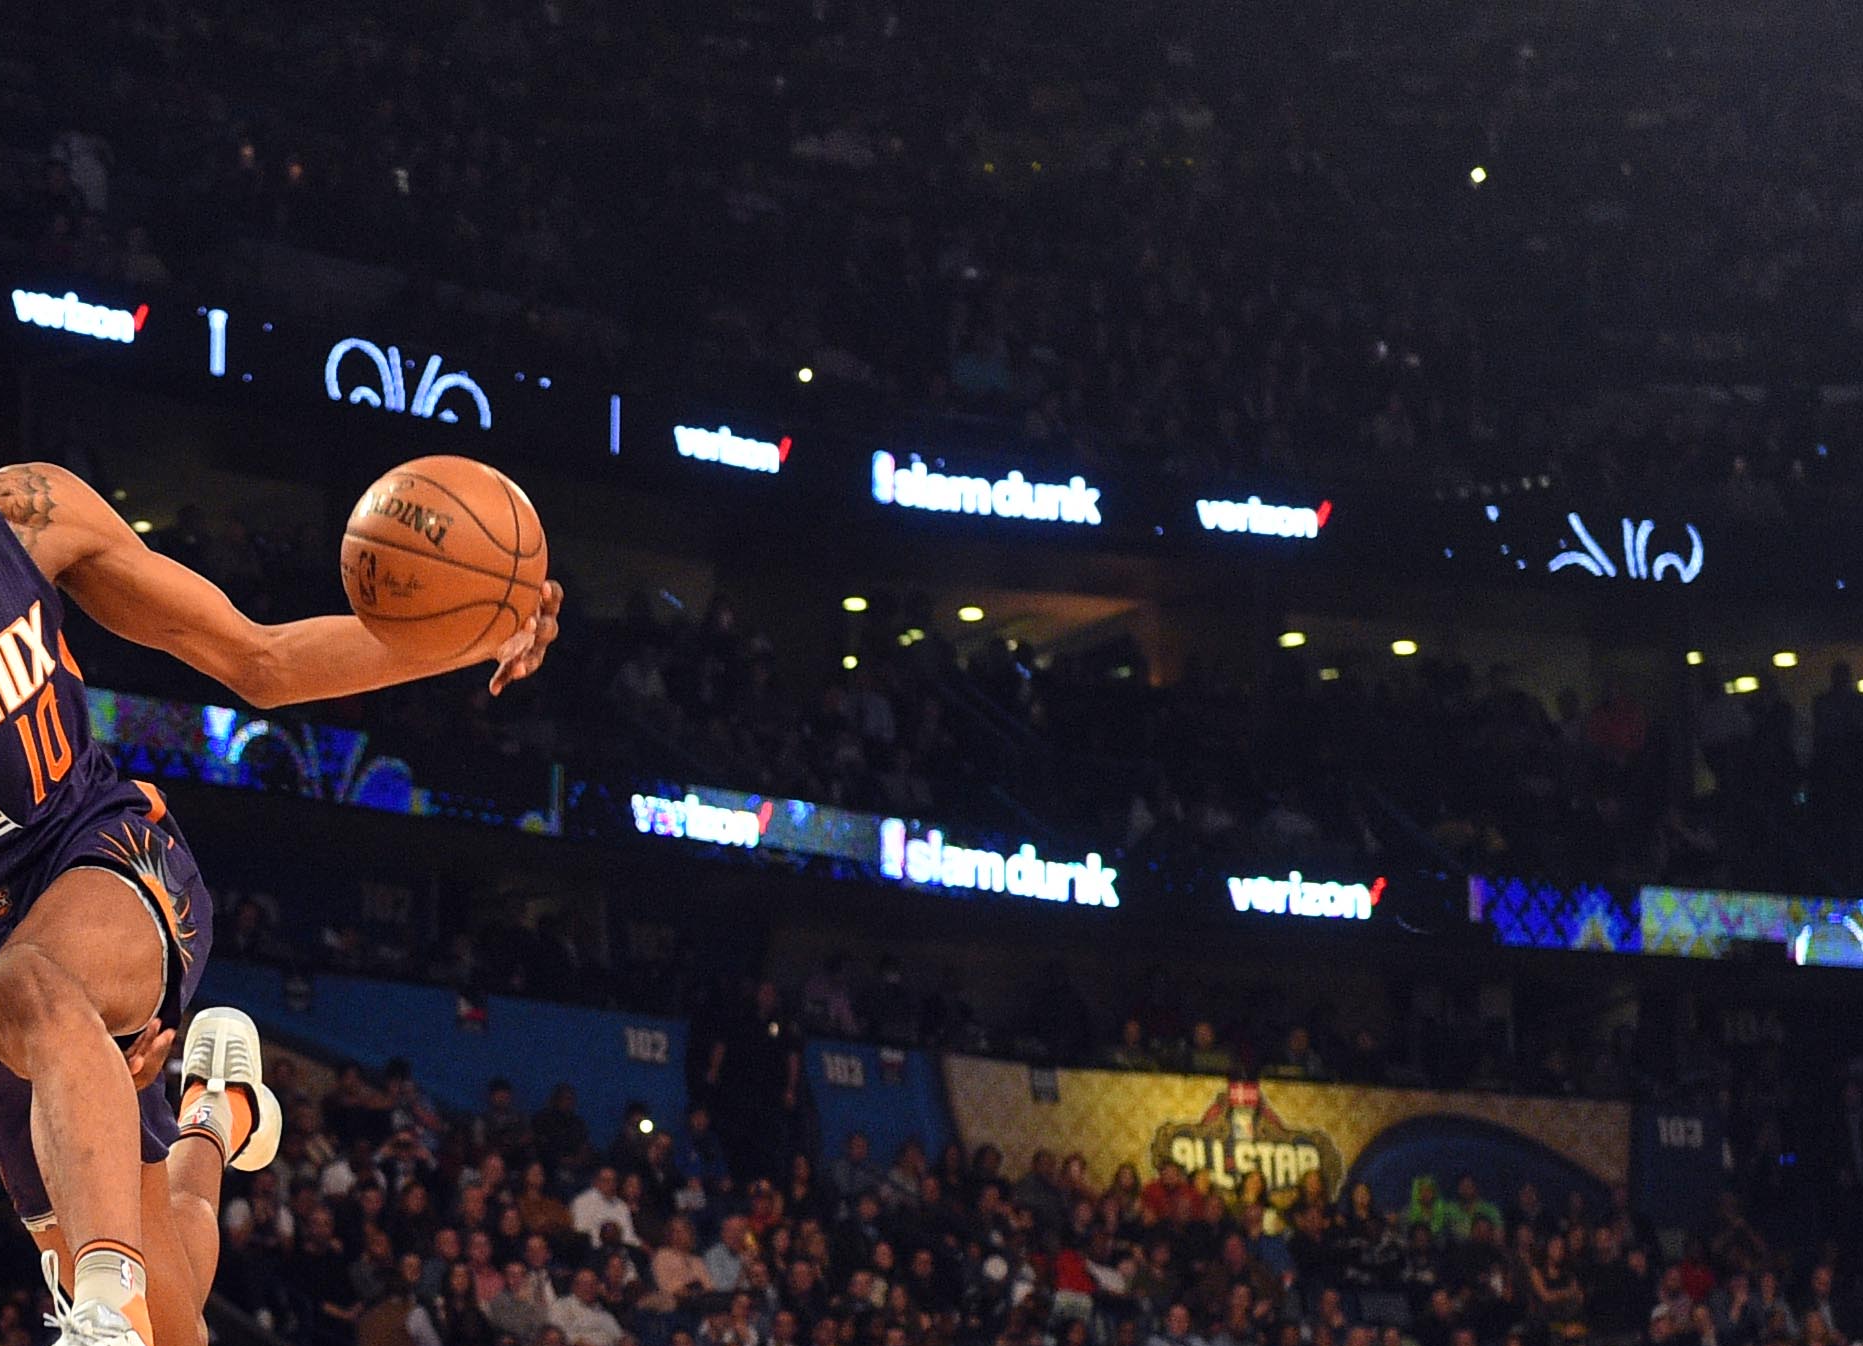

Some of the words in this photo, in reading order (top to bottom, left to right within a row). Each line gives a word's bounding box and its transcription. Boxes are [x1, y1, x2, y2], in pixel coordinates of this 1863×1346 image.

[11, 288, 136, 343] verizon
[673, 425, 780, 474] verizon
[1196, 496, 1318, 539] verizon
[15, 681, 73, 806] 10
[631, 794, 760, 848] verizon
[1228, 869, 1372, 920] verizon
